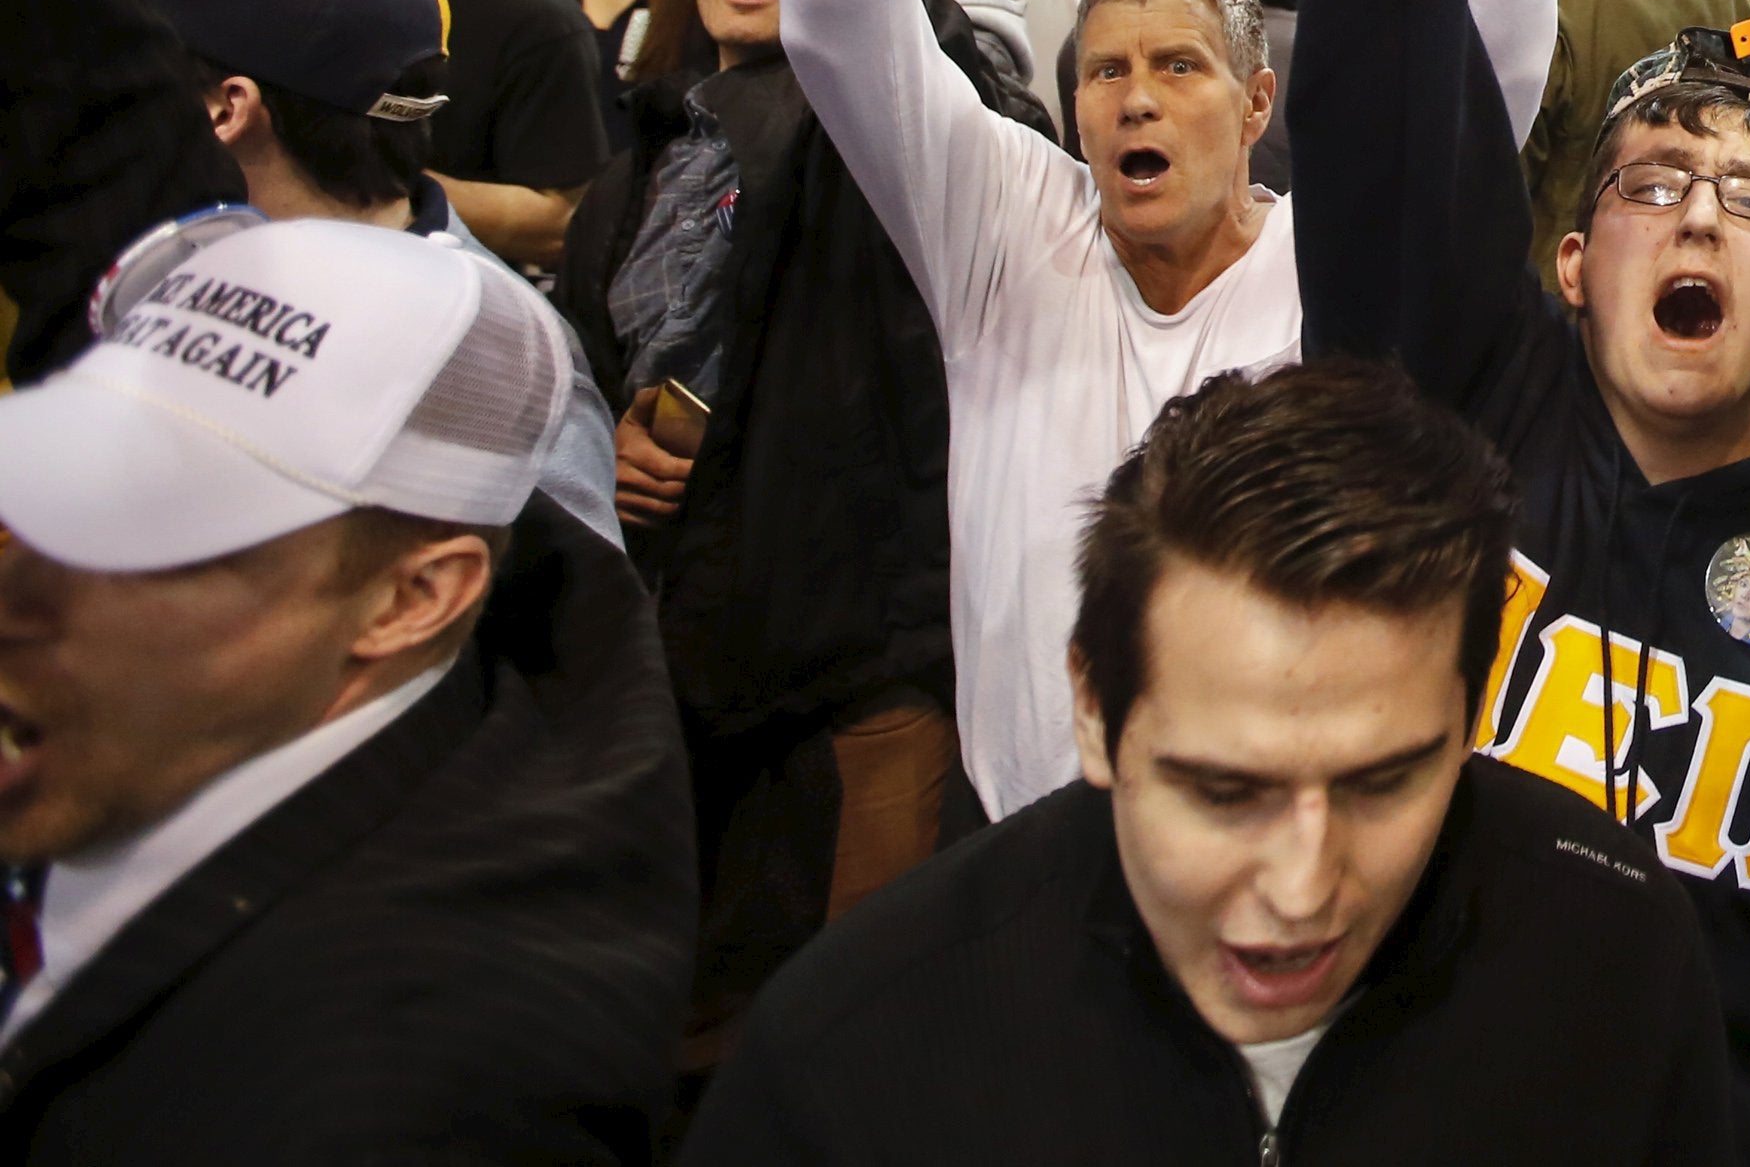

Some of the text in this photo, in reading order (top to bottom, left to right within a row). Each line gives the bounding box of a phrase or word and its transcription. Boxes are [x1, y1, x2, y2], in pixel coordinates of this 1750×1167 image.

[176, 278, 332, 360] AMERICA
[152, 323, 298, 399] AGAIN
[1556, 838, 1647, 884] MICHAEL KORS
